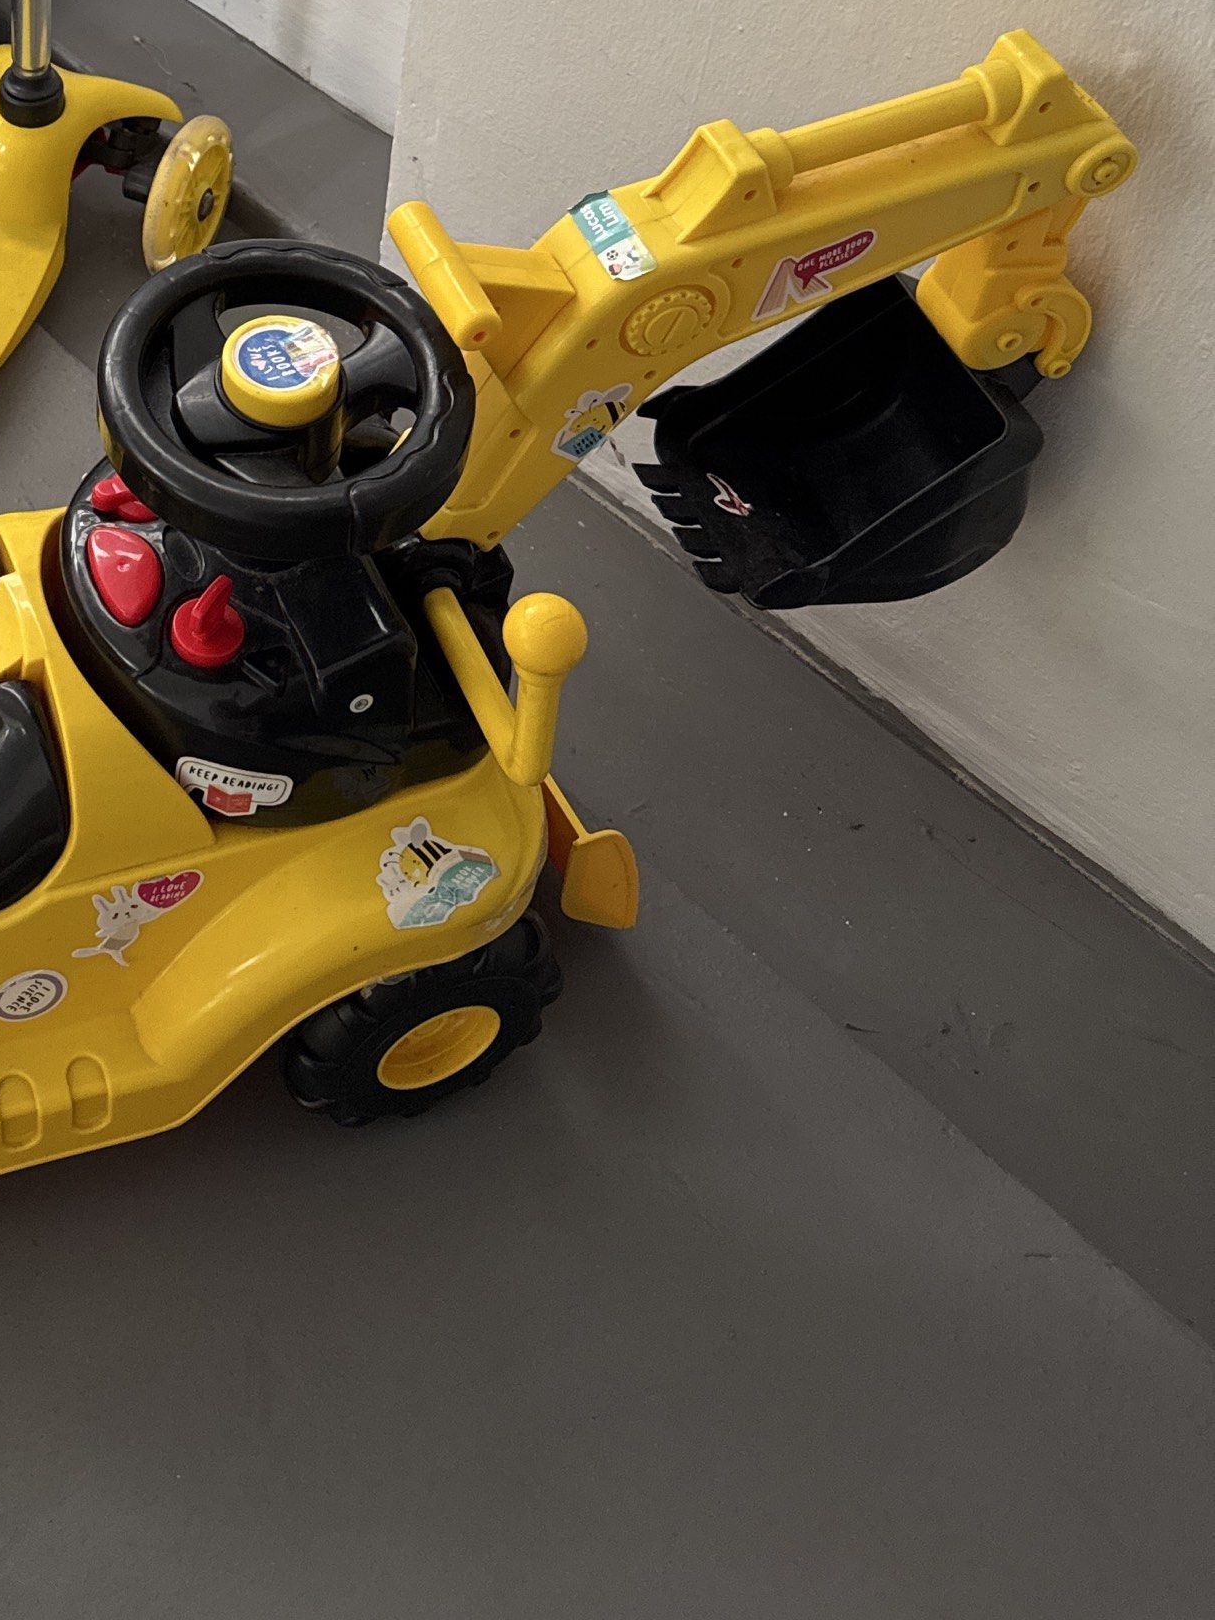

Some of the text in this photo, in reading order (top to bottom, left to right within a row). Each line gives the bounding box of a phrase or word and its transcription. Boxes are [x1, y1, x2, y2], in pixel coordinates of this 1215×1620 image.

[580, 203, 608, 242] Lucas
[599, 203, 619, 227] Lim
[797, 260, 815, 271] ONE
[818, 247, 842, 262] MORE
[262, 345, 296, 376] BOOKS
[188, 765, 280, 793] KEEP READING!
[160, 881, 187, 893] LOVE
[6, 980, 43, 1012] SCIENCE
[19, 991, 45, 1012] LOVE
